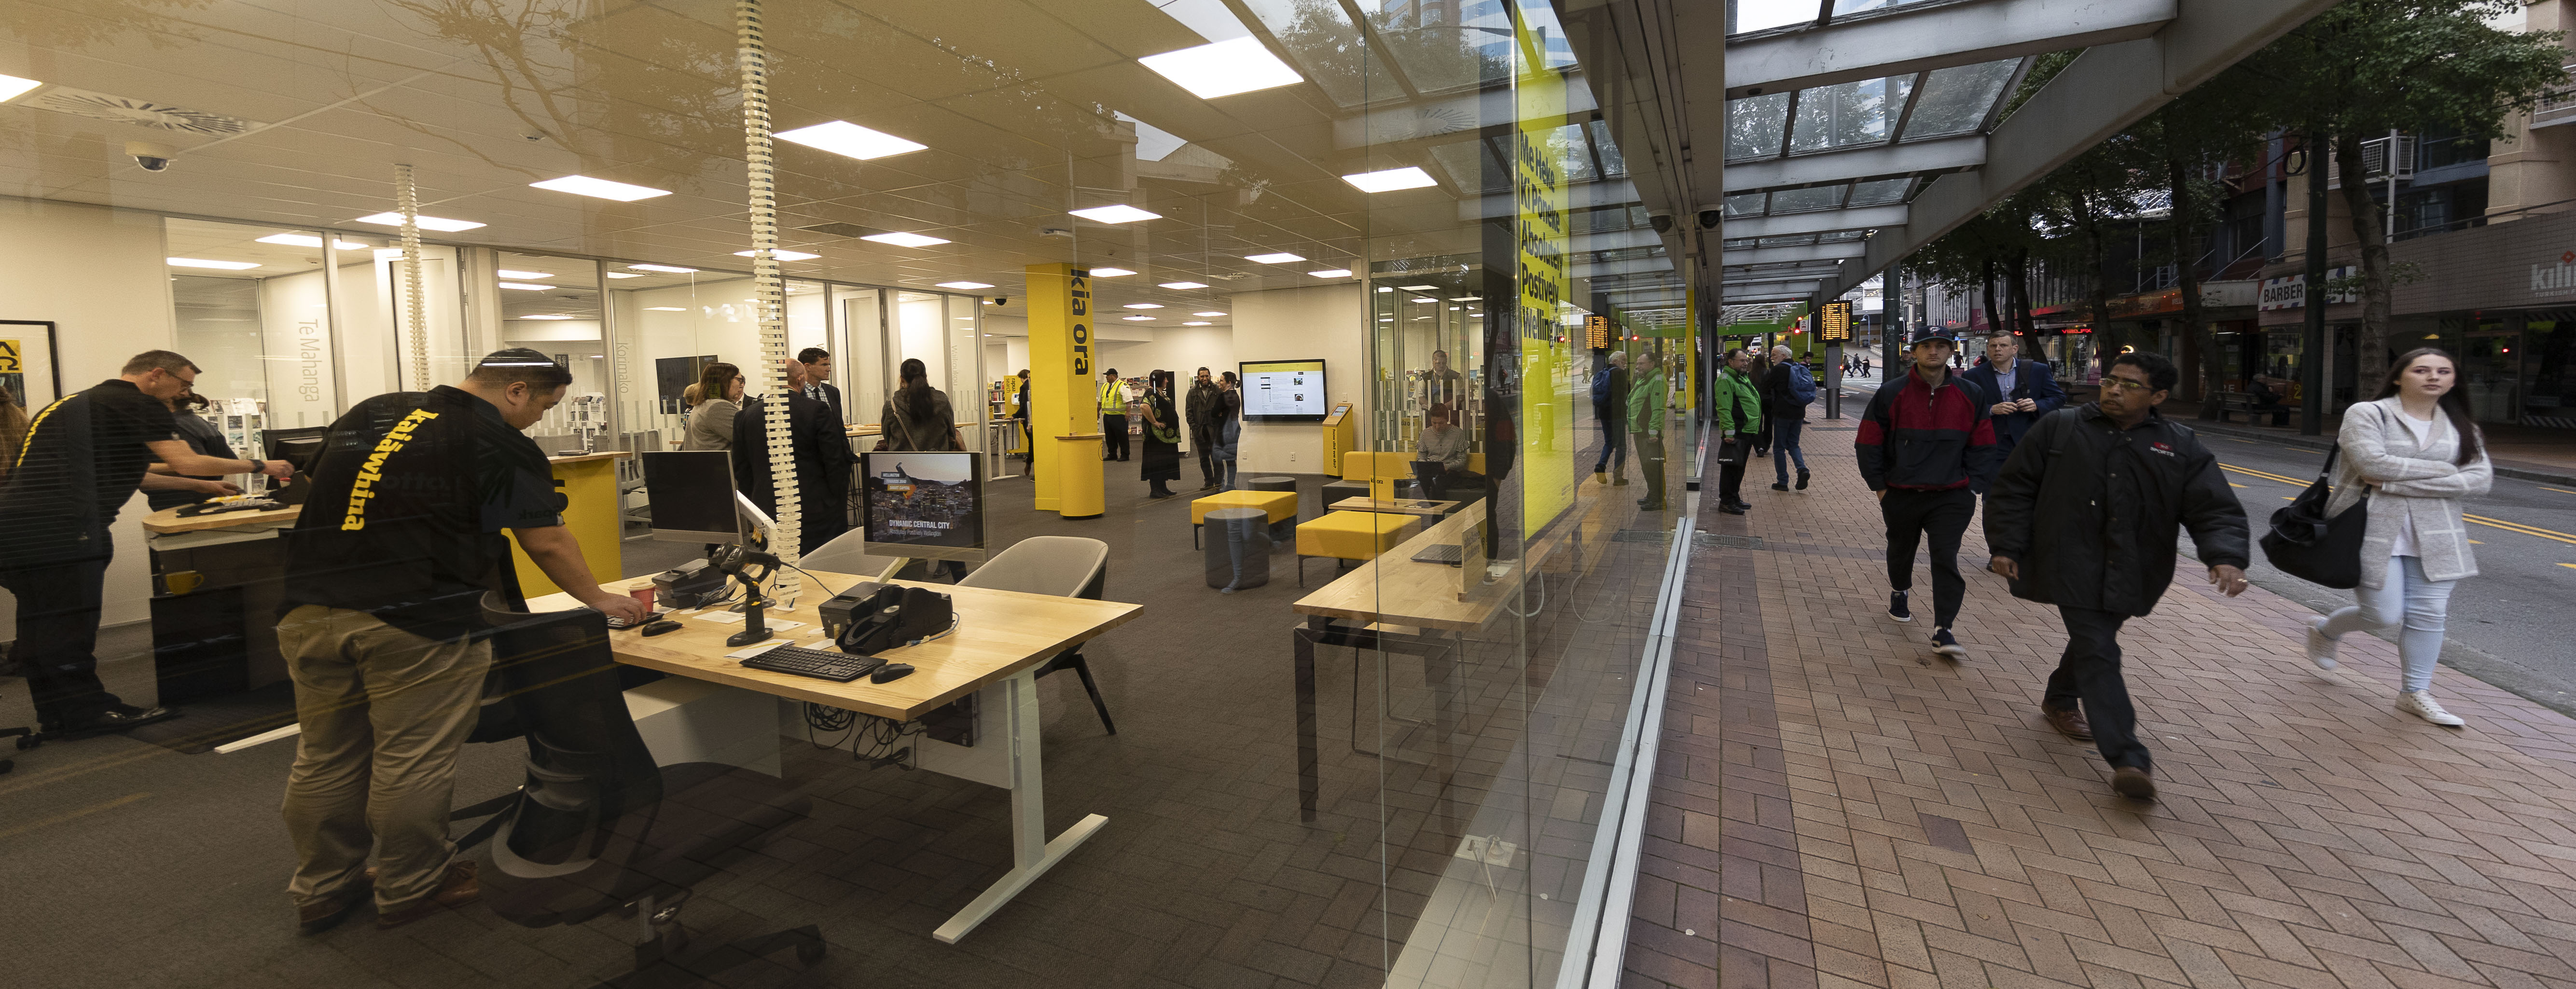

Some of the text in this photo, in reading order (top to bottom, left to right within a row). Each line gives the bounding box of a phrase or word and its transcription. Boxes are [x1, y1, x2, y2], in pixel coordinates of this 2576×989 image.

[1520, 127, 1555, 193] Me Heke
[1521, 172, 1530, 211] Ki
[1522, 220, 1563, 279] Absolutely
[1522, 262, 1559, 313] Postively
[2263, 283, 2303, 303] BARBER
[1070, 268, 1090, 375] kia ora
[298, 318, 322, 402] Te Mahanga
[617, 343, 631, 393] Korimako
[341, 408, 439, 530] kaiāwhina
[1333, 450, 1336, 458] we
[2150, 447, 2174, 457] SPORTS
